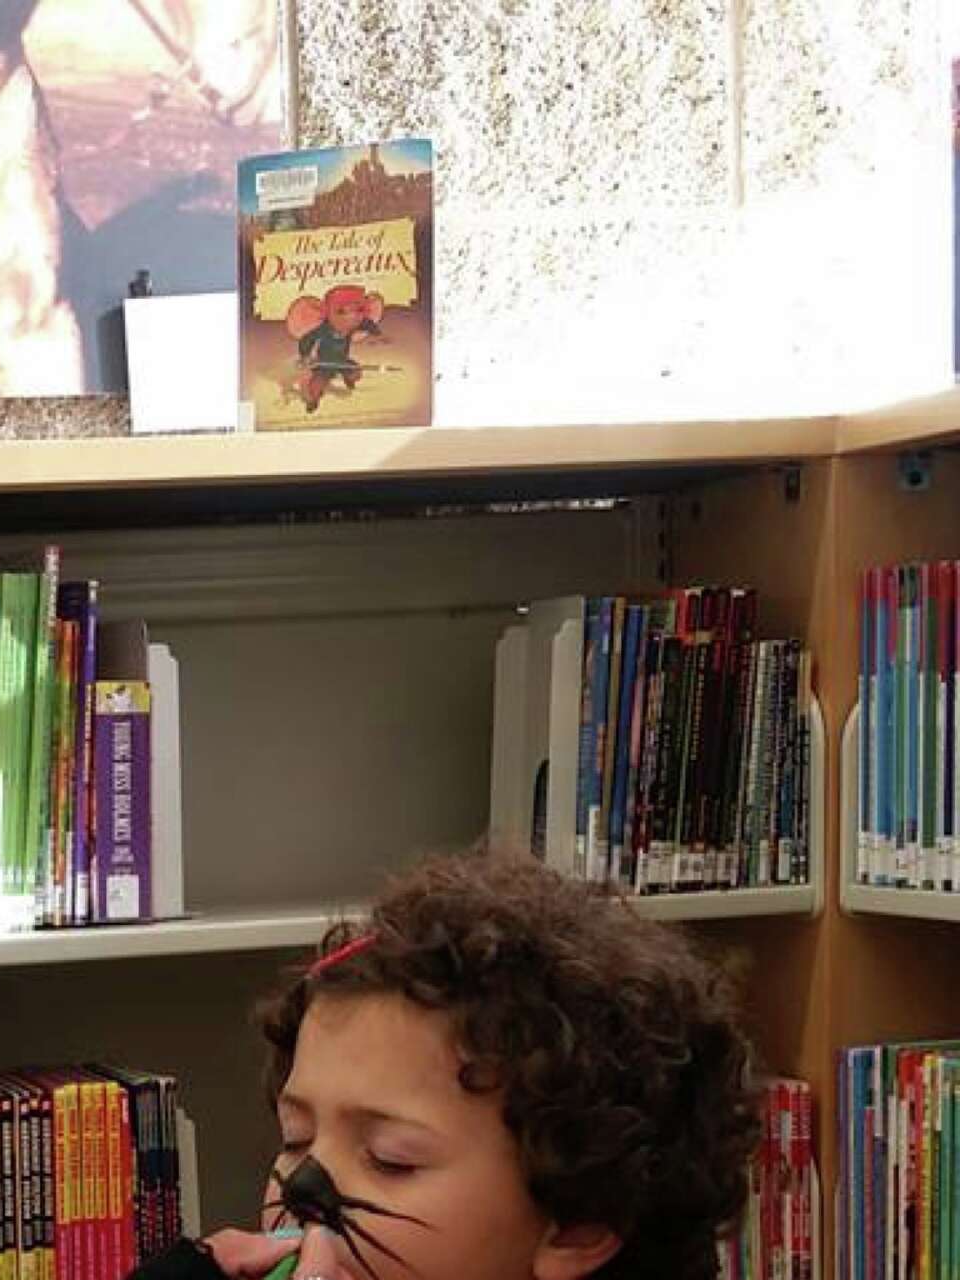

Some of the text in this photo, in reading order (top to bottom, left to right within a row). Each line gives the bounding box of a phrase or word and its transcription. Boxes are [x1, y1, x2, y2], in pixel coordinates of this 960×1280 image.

[296, 229, 385, 253] The Tale of
[256, 251, 417, 291] Despereaux
